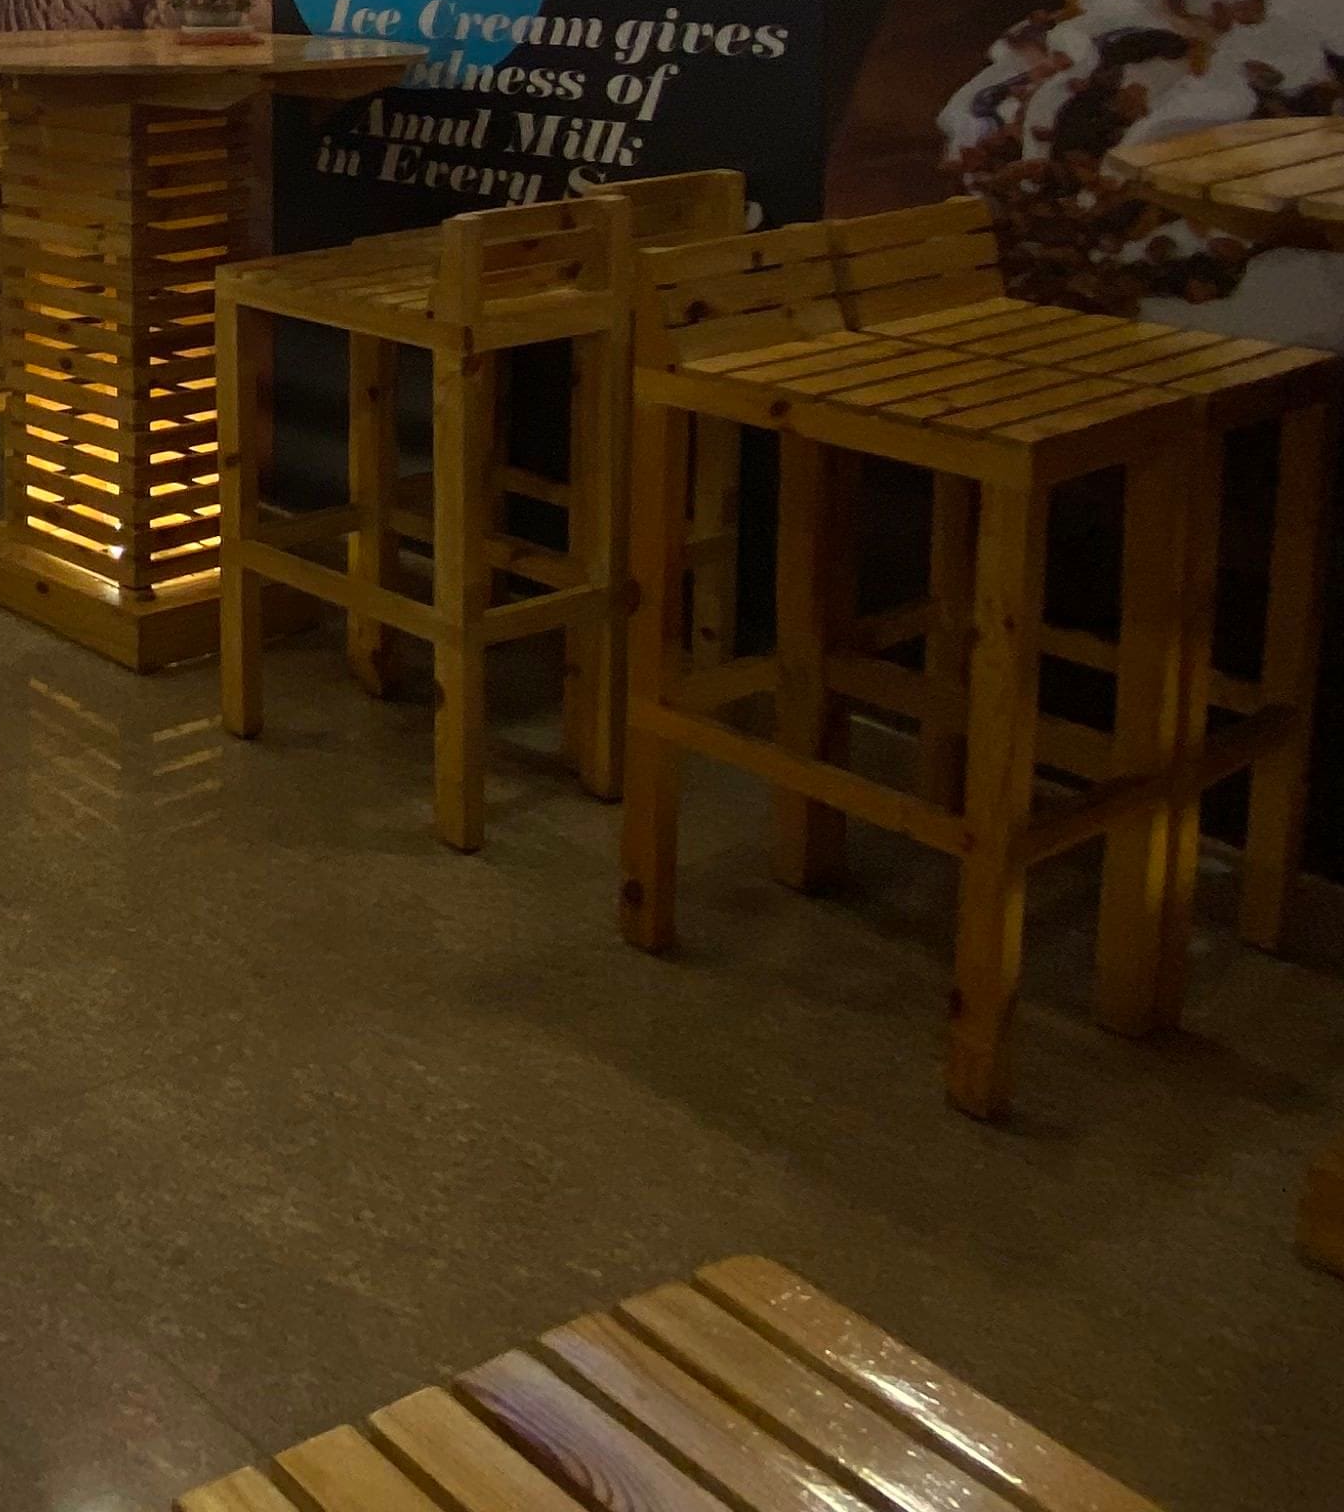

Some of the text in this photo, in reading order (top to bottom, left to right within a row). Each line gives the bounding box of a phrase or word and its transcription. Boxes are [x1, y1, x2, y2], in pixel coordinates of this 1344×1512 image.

[614, 7, 790, 66] gives
[605, 63, 680, 121] of
[351, 98, 647, 167] Amul Milk
[315, 134, 362, 177] in
[375, 142, 543, 207] Every
